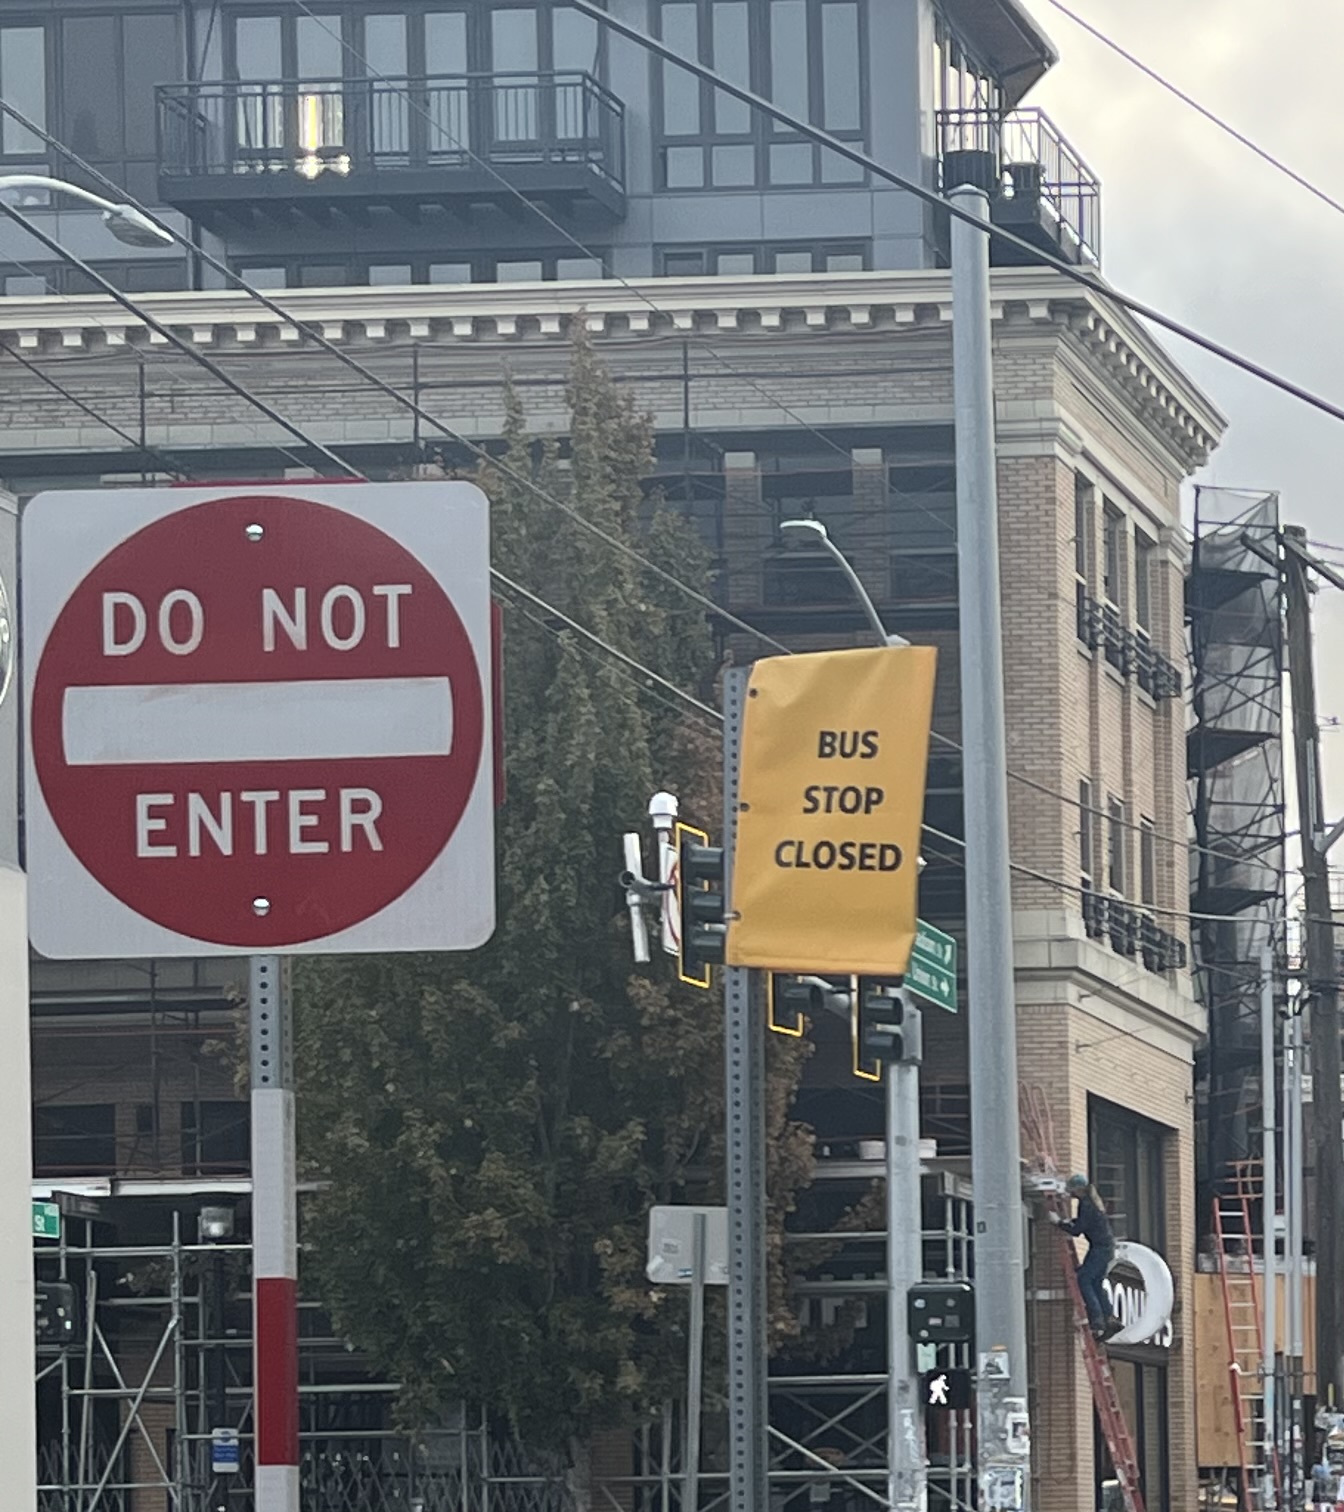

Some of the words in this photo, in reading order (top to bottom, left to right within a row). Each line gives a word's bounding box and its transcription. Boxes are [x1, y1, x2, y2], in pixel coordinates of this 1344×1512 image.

[101, 589, 206, 657] DO
[262, 583, 414, 652] NOT
[816, 730, 880, 760] BUS
[802, 785, 885, 815] STOP
[135, 787, 384, 859] ENTER
[773, 839, 903, 873] CLOSED
